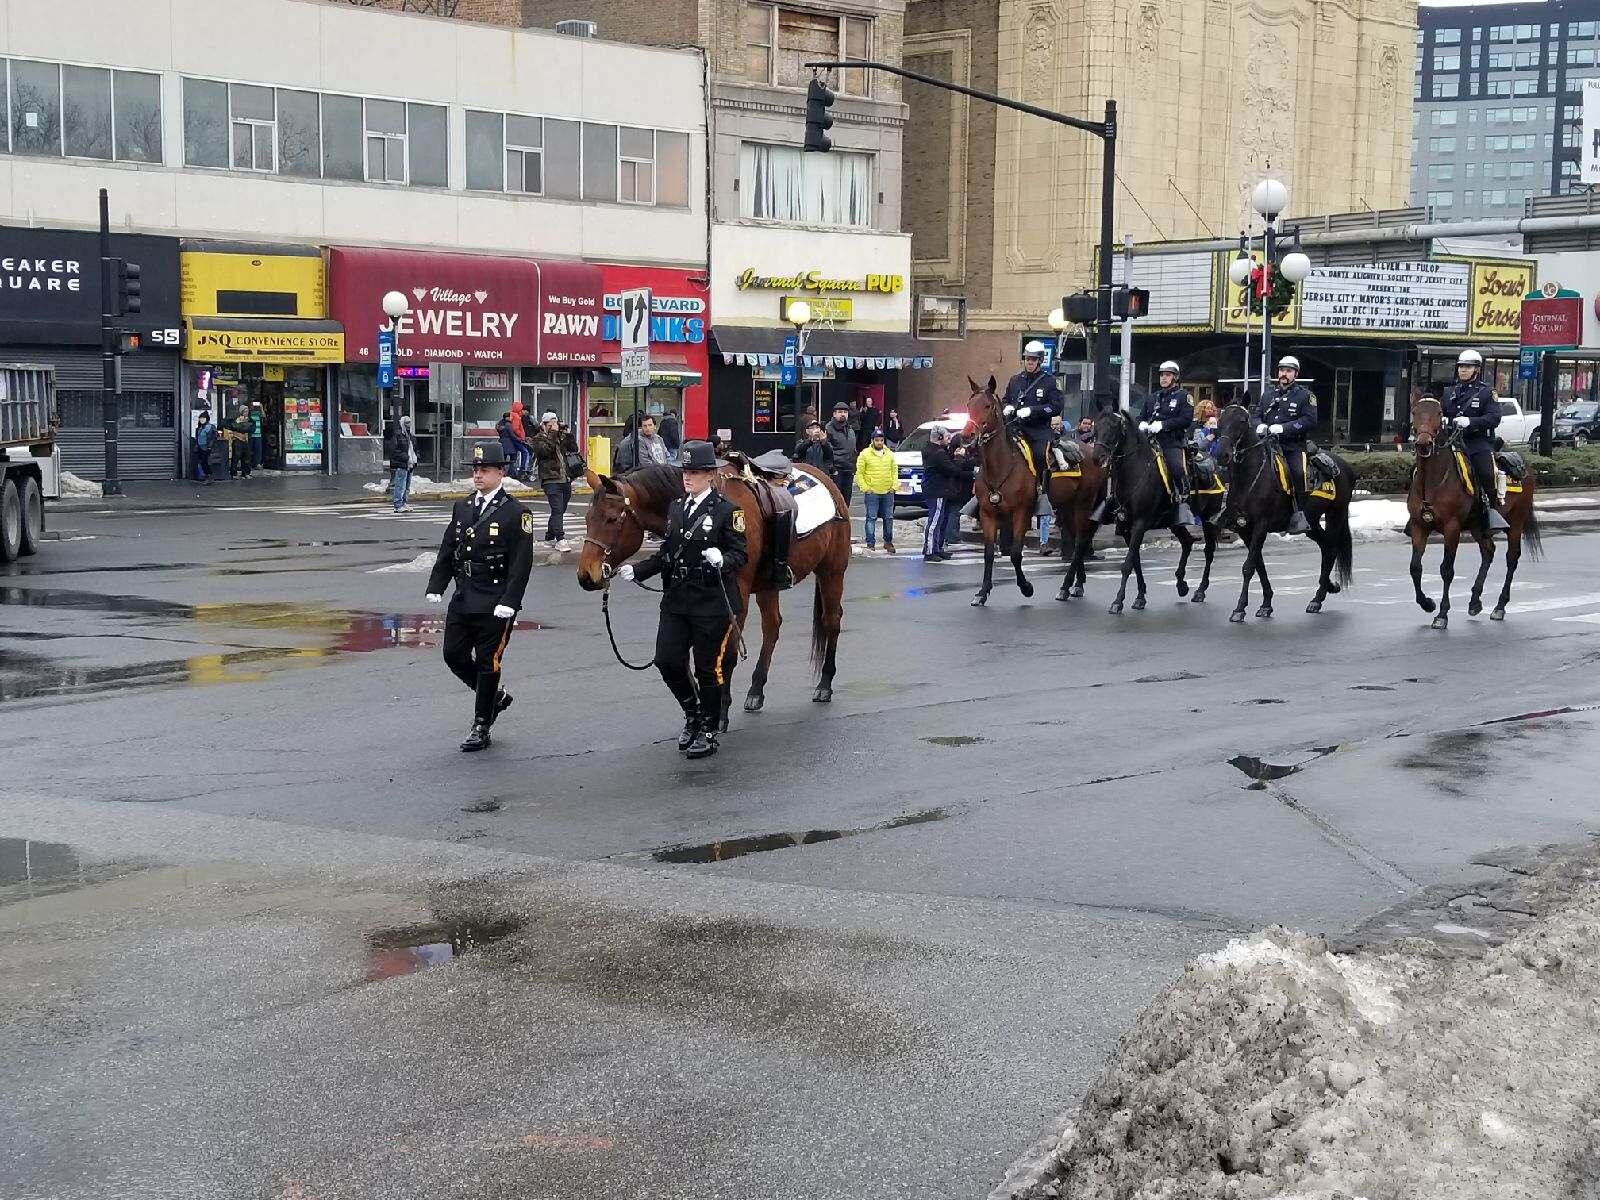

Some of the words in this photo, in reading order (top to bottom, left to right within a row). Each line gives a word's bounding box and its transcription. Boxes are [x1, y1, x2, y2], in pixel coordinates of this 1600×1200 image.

[1416, 263, 1440, 273] FULOP
[866, 274, 904, 293] PUB
[1388, 273, 1412, 282] SOCIETY
[430, 287, 472, 306] Village
[549, 295, 561, 304] We
[562, 296, 576, 307] Buy
[578, 297, 595, 307] Gold
[1304, 293, 1334, 301] JERSEY
[1338, 293, 1357, 302] CITY
[1360, 295, 1391, 305] MAYOR'S
[1395, 296, 1434, 306] CHRISTMAS
[1437, 299, 1468, 308] CONCERT
[1332, 305, 1349, 314] SAT
[1352, 305, 1366, 315] DEC
[1423, 309, 1441, 318] FREE
[543, 312, 599, 337] PAWN
[1320, 316, 1361, 326] PRODUCED
[1365, 317, 1376, 327] BY
[1379, 318, 1415, 328] ANTHONY
[1530, 313, 1568, 324] JOURNAL
[601, 314, 705, 344] DNKS
[1533, 324, 1564, 334] SQUARE
[236, 336, 304, 347] CONVENIENCE
[308, 337, 338, 347] STORE
[359, 347, 369, 356] 46
[396, 348, 413, 357] OLD
[424, 348, 464, 358] DIAMOND
[473, 349, 503, 359] WATCH
[546, 351, 568, 361] CASH
[570, 353, 596, 363] LOANS
[625, 355, 646, 367] KEEP
[468, 376, 484, 388] BUY
